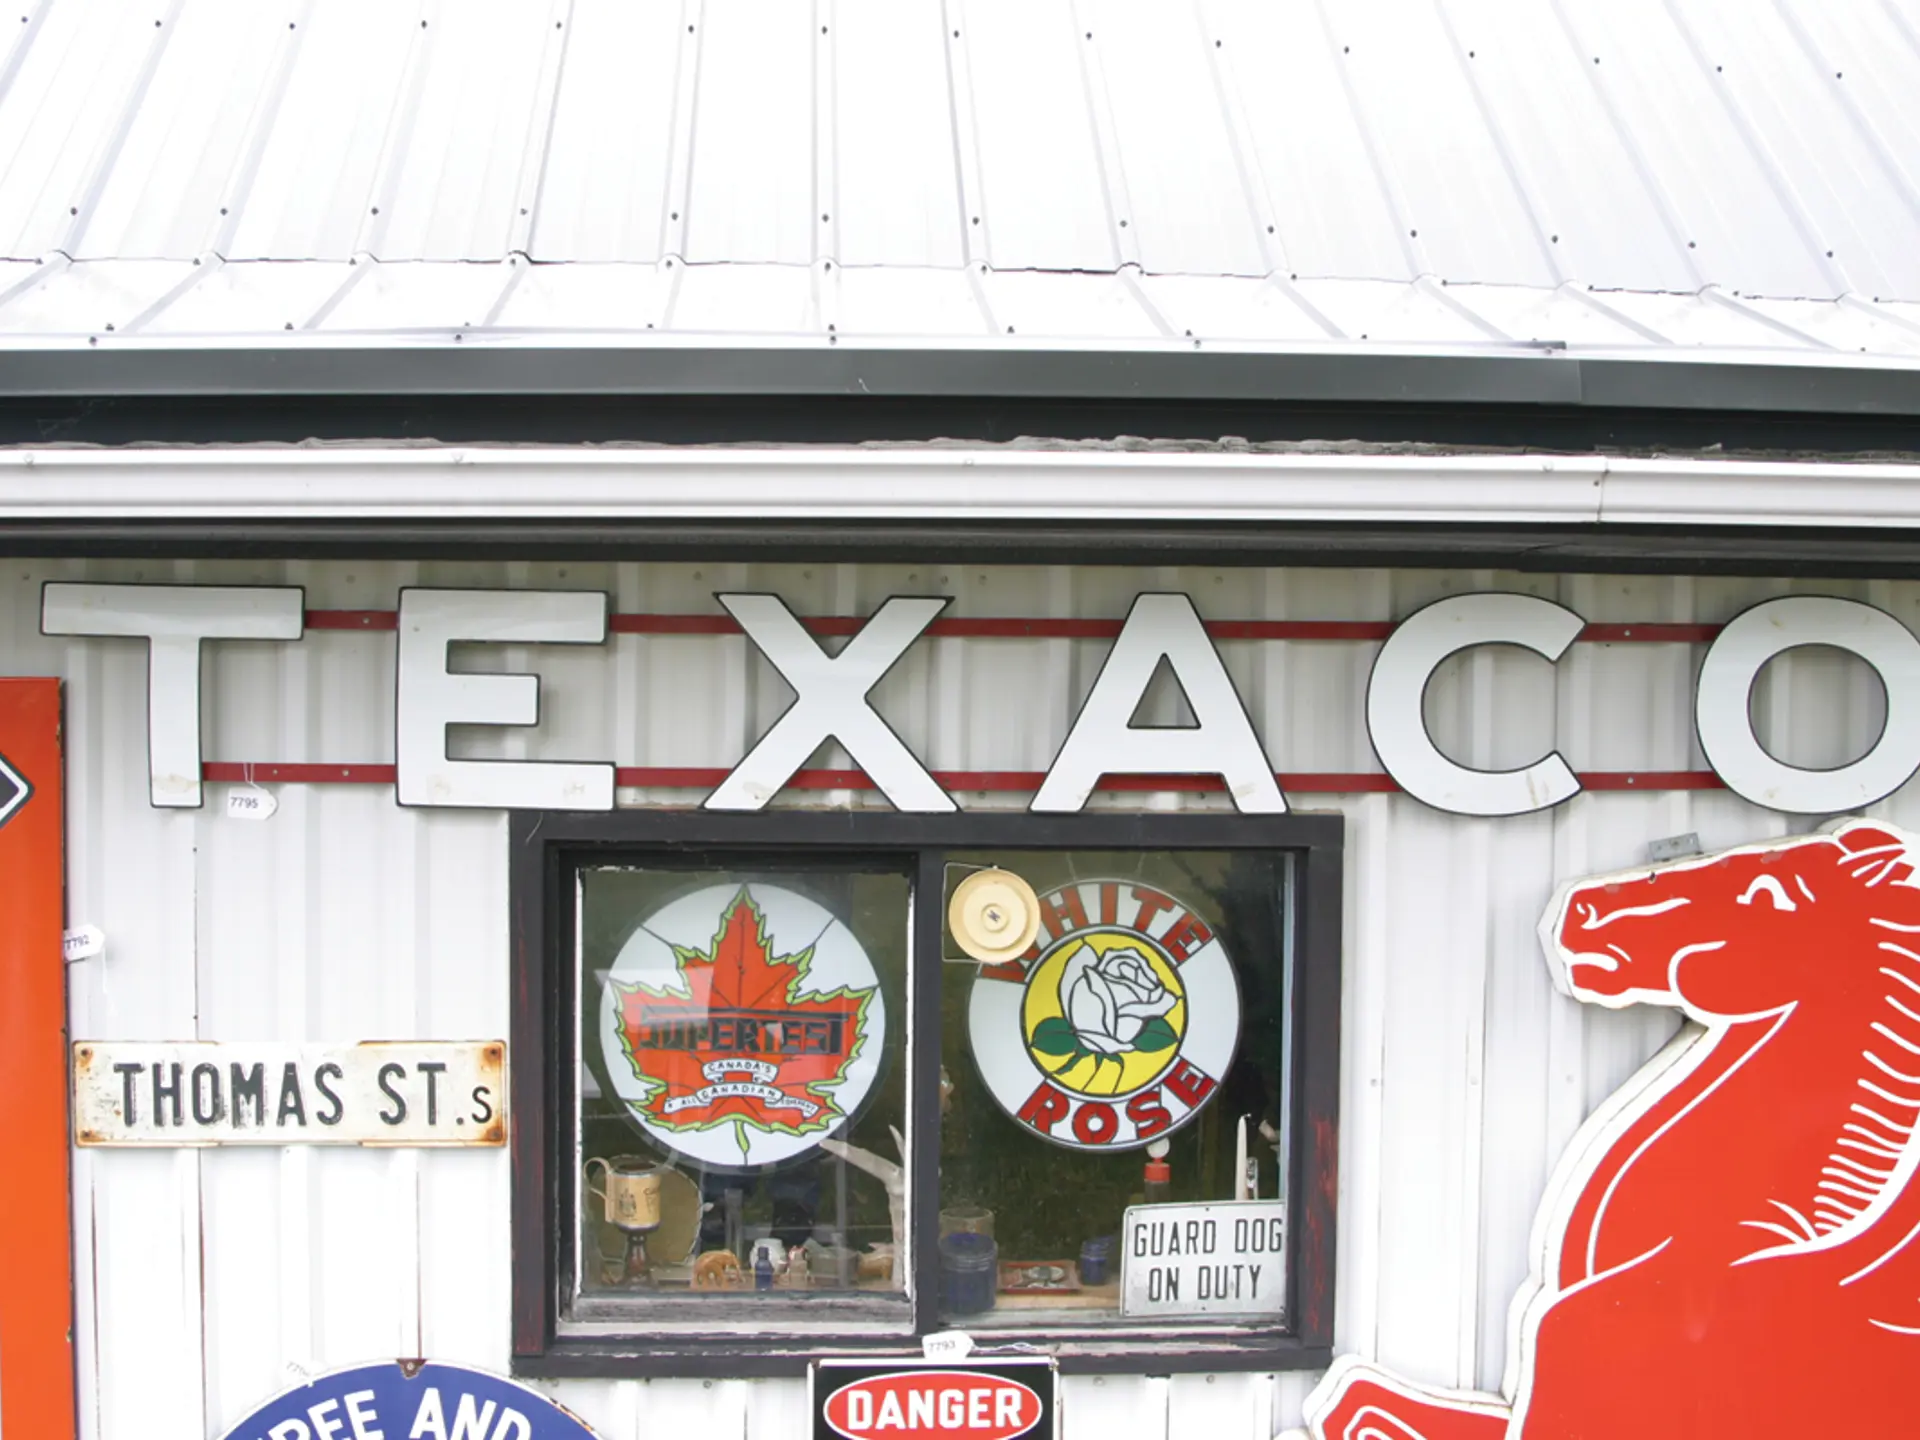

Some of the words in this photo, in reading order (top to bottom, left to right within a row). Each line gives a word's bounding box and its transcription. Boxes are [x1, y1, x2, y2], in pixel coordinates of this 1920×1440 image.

[41, 582, 1920, 816] TEXACO
[230, 797, 259, 809] 7795
[708, 1061, 771, 1073] CANADA'S
[113, 1062, 344, 1130] THOMAS
[701, 1084, 776, 1099] CANADIAN
[1016, 1059, 1221, 1146] ROSE
[1134, 1219, 1217, 1258] GUARD
[1234, 1217, 1284, 1255] DOG
[1147, 1268, 1180, 1303] ON
[1197, 1265, 1262, 1301] DUTY
[928, 1340, 956, 1352] 7793
[847, 1388, 1022, 1430] DANGER
